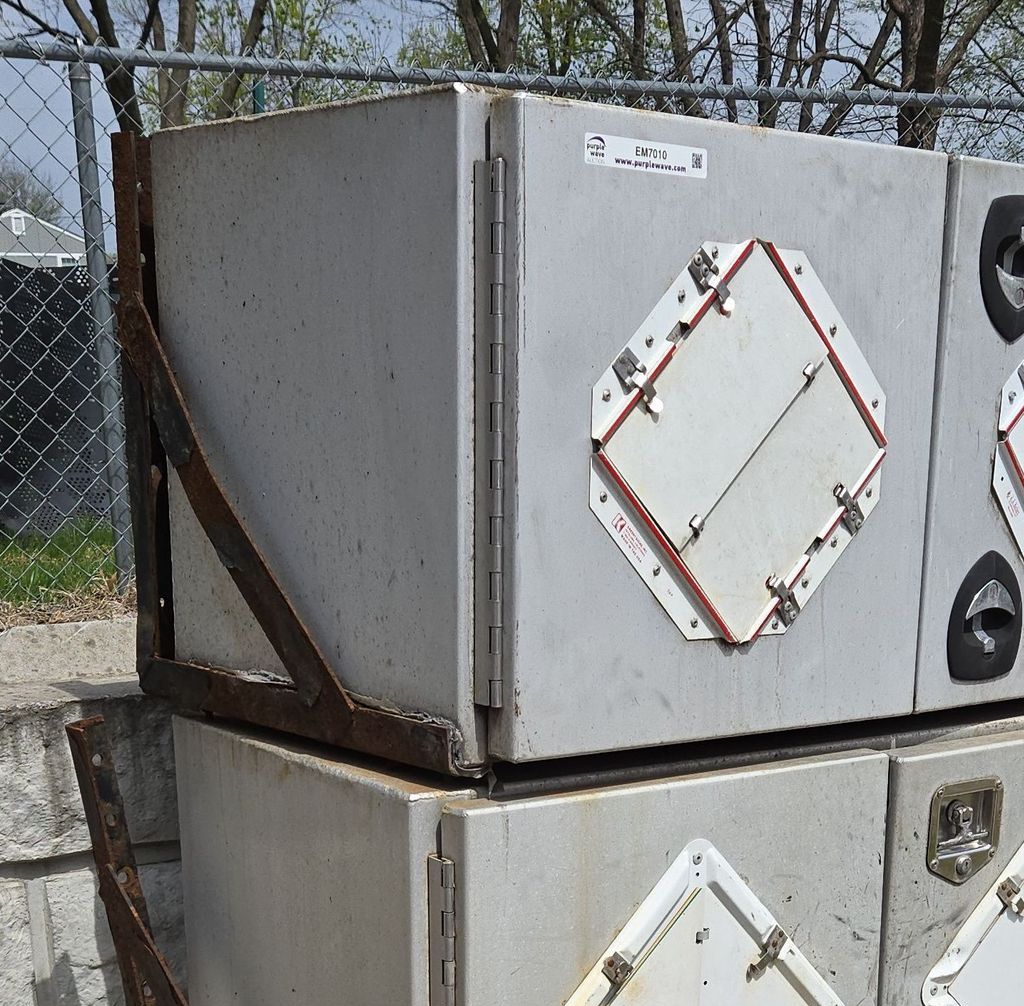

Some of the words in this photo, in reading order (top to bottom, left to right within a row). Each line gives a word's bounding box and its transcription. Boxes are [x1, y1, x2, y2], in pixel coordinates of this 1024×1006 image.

[586, 142, 606, 152] purple
[635, 146, 668, 160] EM7010
[615, 157, 687, 173] www.purplewave.com
